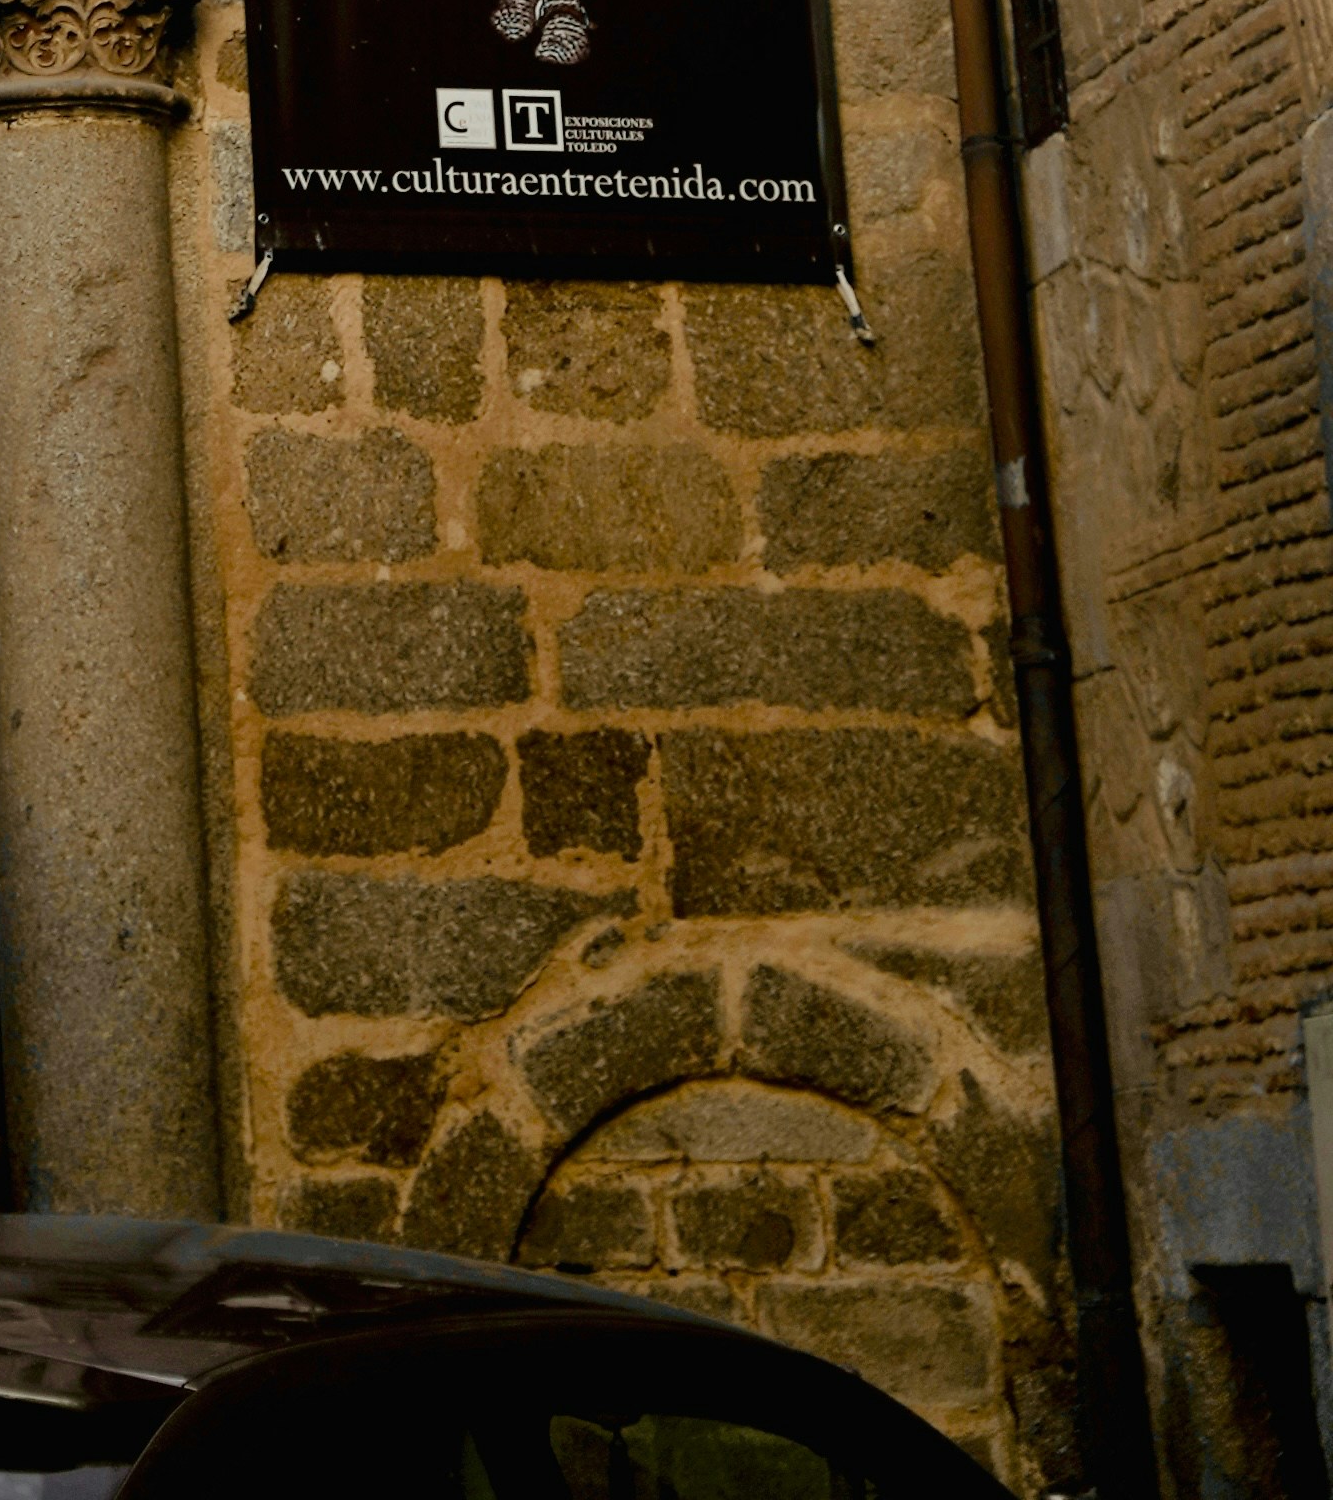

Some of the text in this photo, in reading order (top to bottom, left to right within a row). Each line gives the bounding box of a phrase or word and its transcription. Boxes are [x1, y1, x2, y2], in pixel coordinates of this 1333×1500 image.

[514, 102, 550, 139] T
[563, 115, 654, 130] EXPOSICIONES
[564, 129, 645, 142] CULTURALES
[565, 141, 618, 153] TOLEDO
[281, 158, 817, 203] www.culturaentretenida.com
